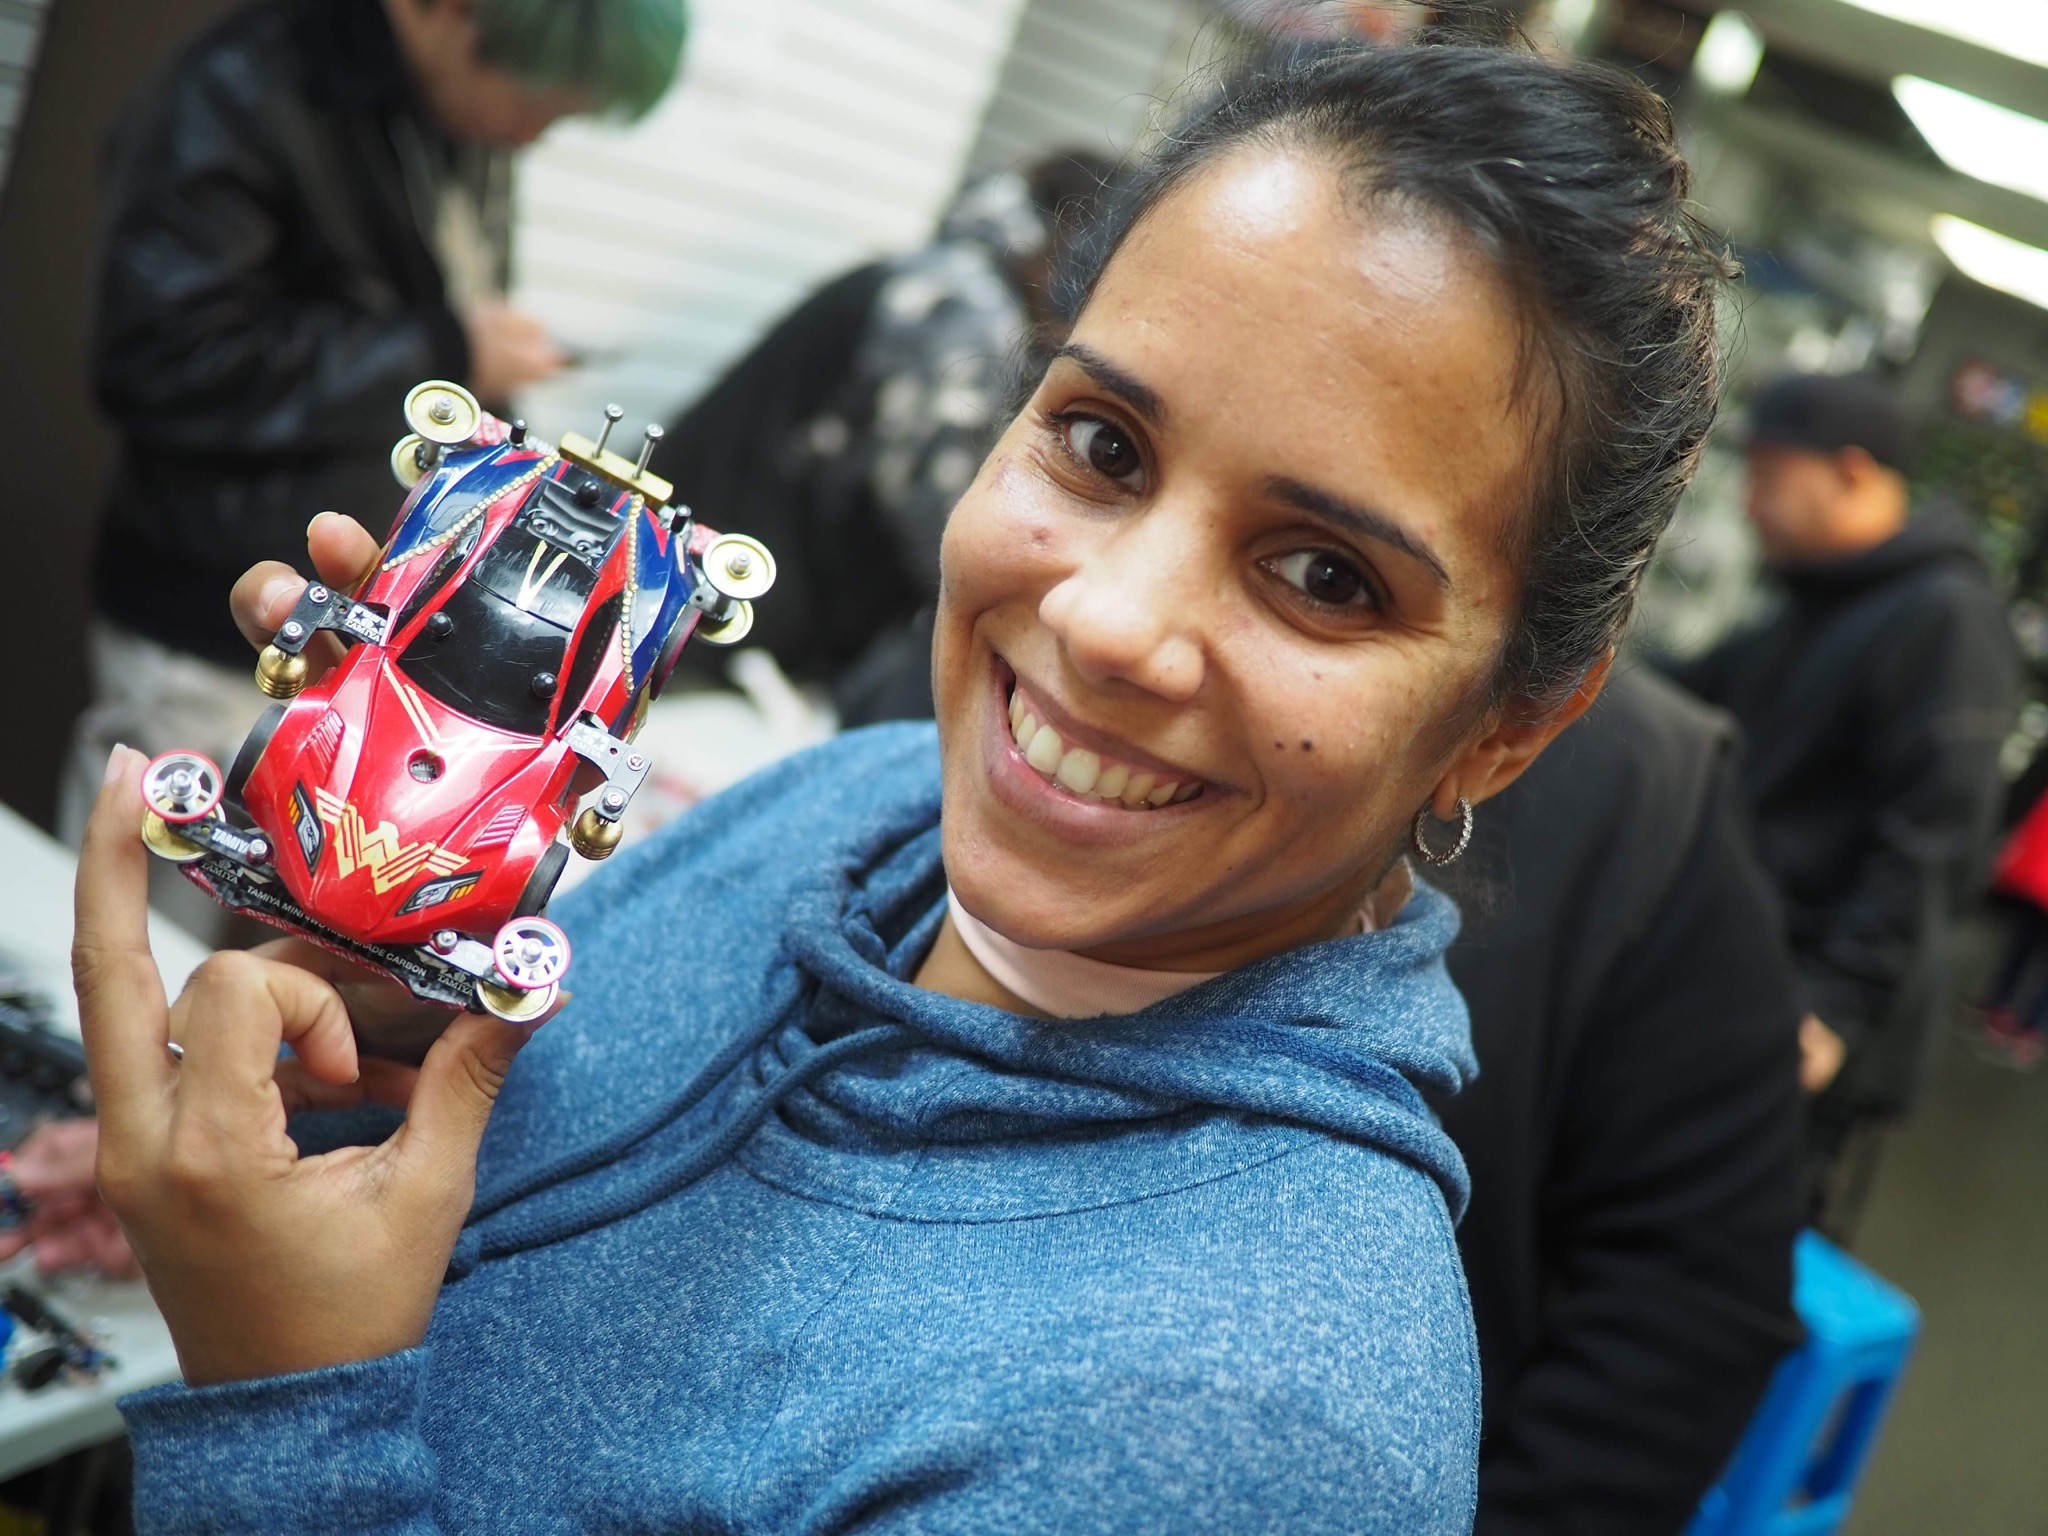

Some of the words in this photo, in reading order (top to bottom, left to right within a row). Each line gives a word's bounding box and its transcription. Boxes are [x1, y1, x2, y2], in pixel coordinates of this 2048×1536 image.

[345, 618, 380, 642] TAMIYA
[201, 861, 239, 885] TAMIYA
[247, 885, 281, 908] TAMIYA
[281, 902, 305, 919] MINI
[386, 953, 428, 977] CARBON
[437, 973, 474, 997] TAMIYA
